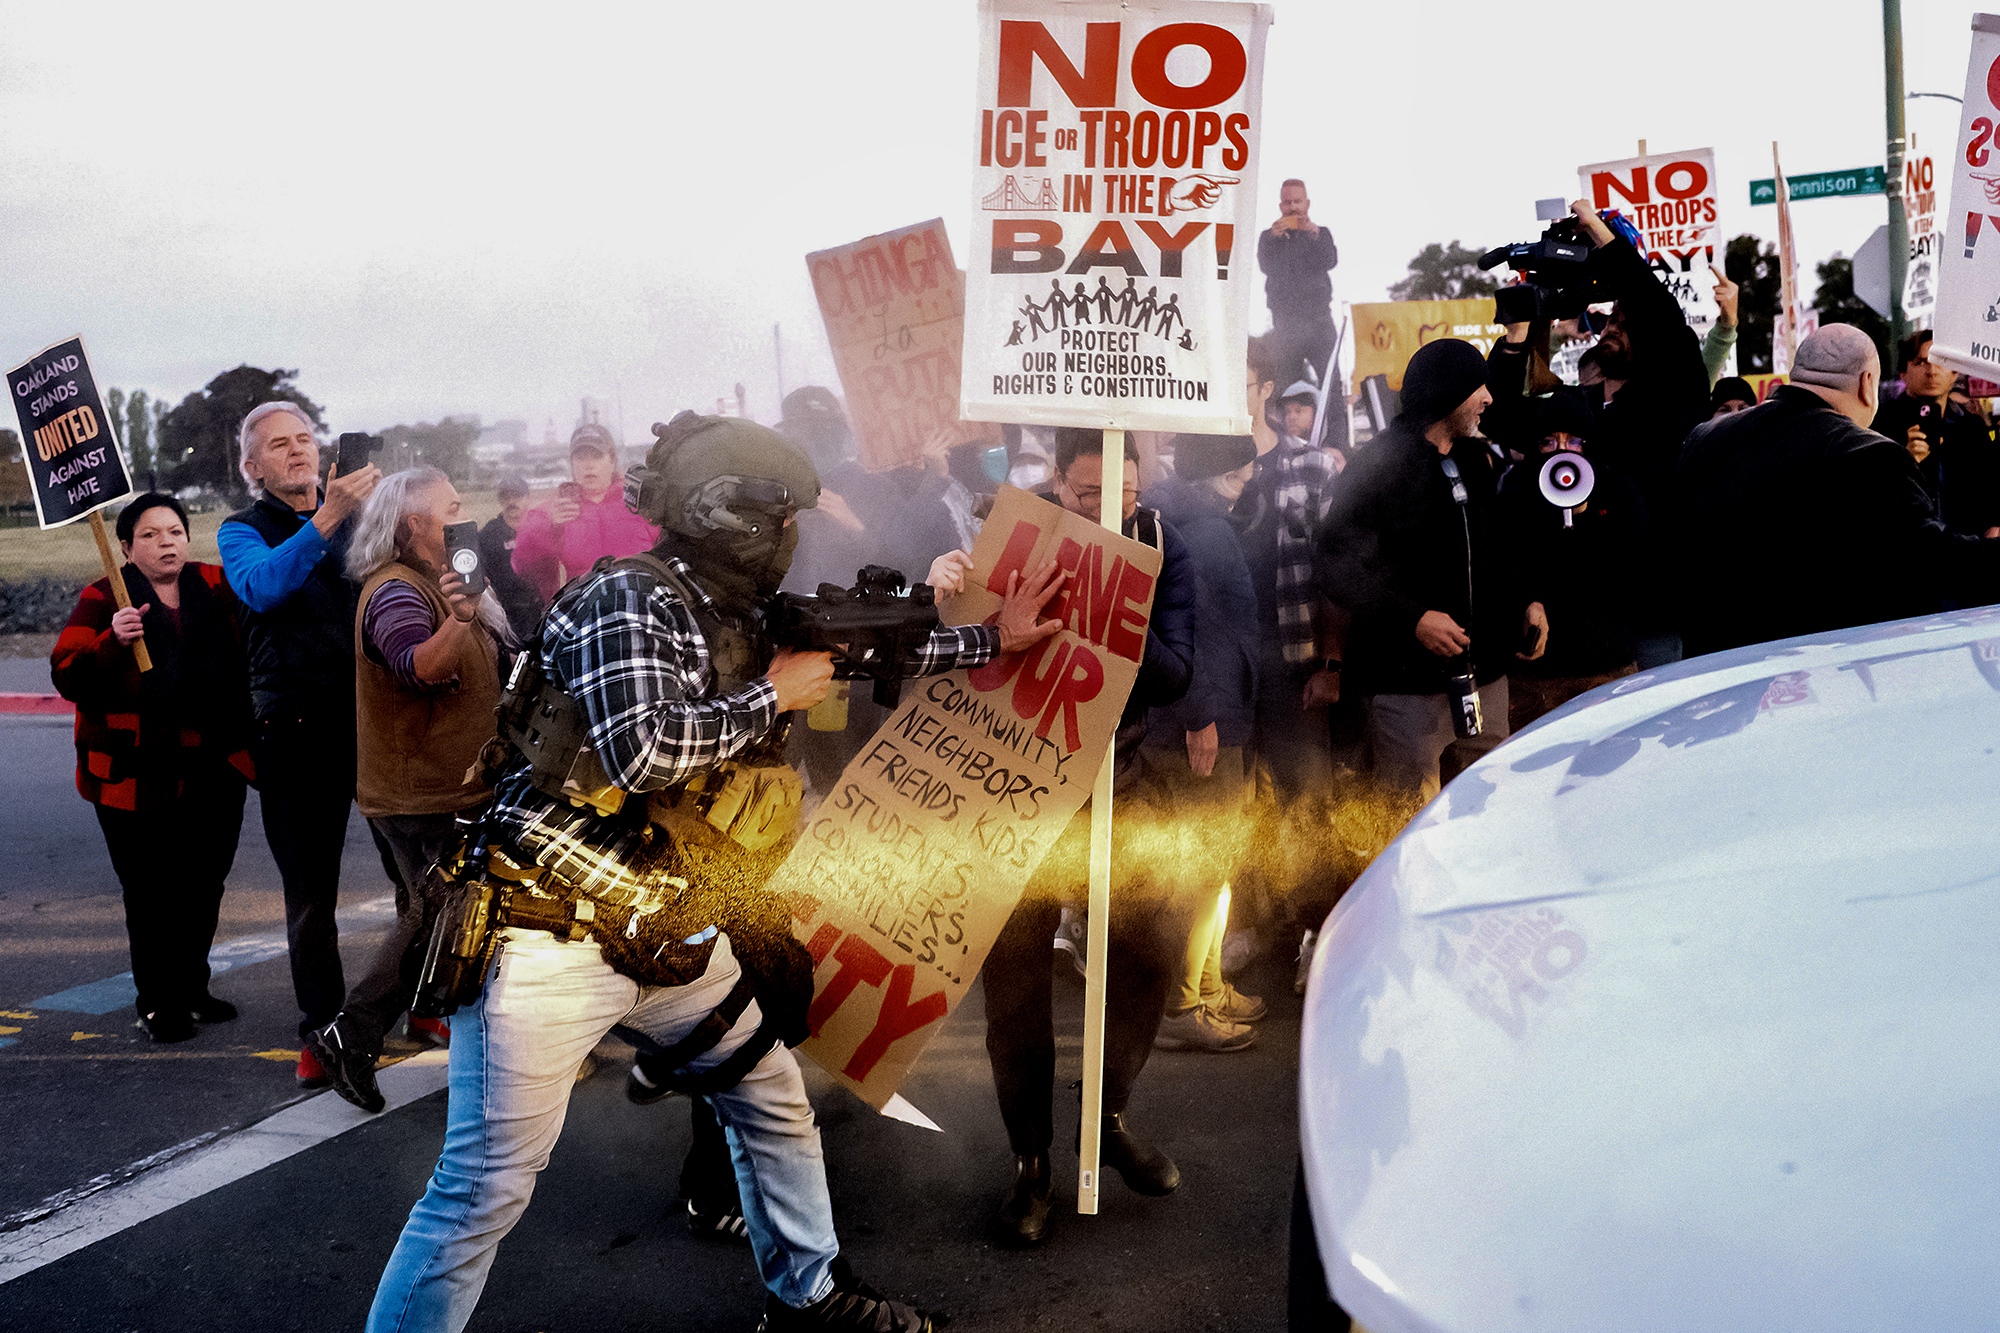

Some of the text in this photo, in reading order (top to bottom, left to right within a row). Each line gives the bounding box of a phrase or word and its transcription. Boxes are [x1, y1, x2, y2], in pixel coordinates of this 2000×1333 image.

[997, 19, 1247, 110] NO
[980, 109, 1251, 171] ICE OR TROOPS
[1062, 174, 1155, 214] IN THE
[1591, 161, 1708, 210] NO
[1789, 176, 1857, 197] ennison
[1906, 157, 1933, 195] NO
[1634, 197, 1717, 230] TROOPS
[991, 219, 1235, 281] BAY!
[1648, 229, 1674, 249] THE
[812, 228, 958, 317] CHINGA
[1647, 245, 1714, 274] AY!
[1060, 329, 1140, 353] PROTECT
[1453, 325, 1482, 336] SIDE
[16, 355, 79, 397] OAKLAND
[1022, 352, 1173, 378] OUR NEIGHBORS,
[30, 380, 79, 417] STANDS
[993, 375, 1208, 402] RIGHTS & CONSTITUTION
[33, 405, 99, 462] UNITED
[49, 447, 106, 488] AGAINST
[67, 476, 100, 505] HATE
[926, 678, 1073, 785] COMMUNITY,
